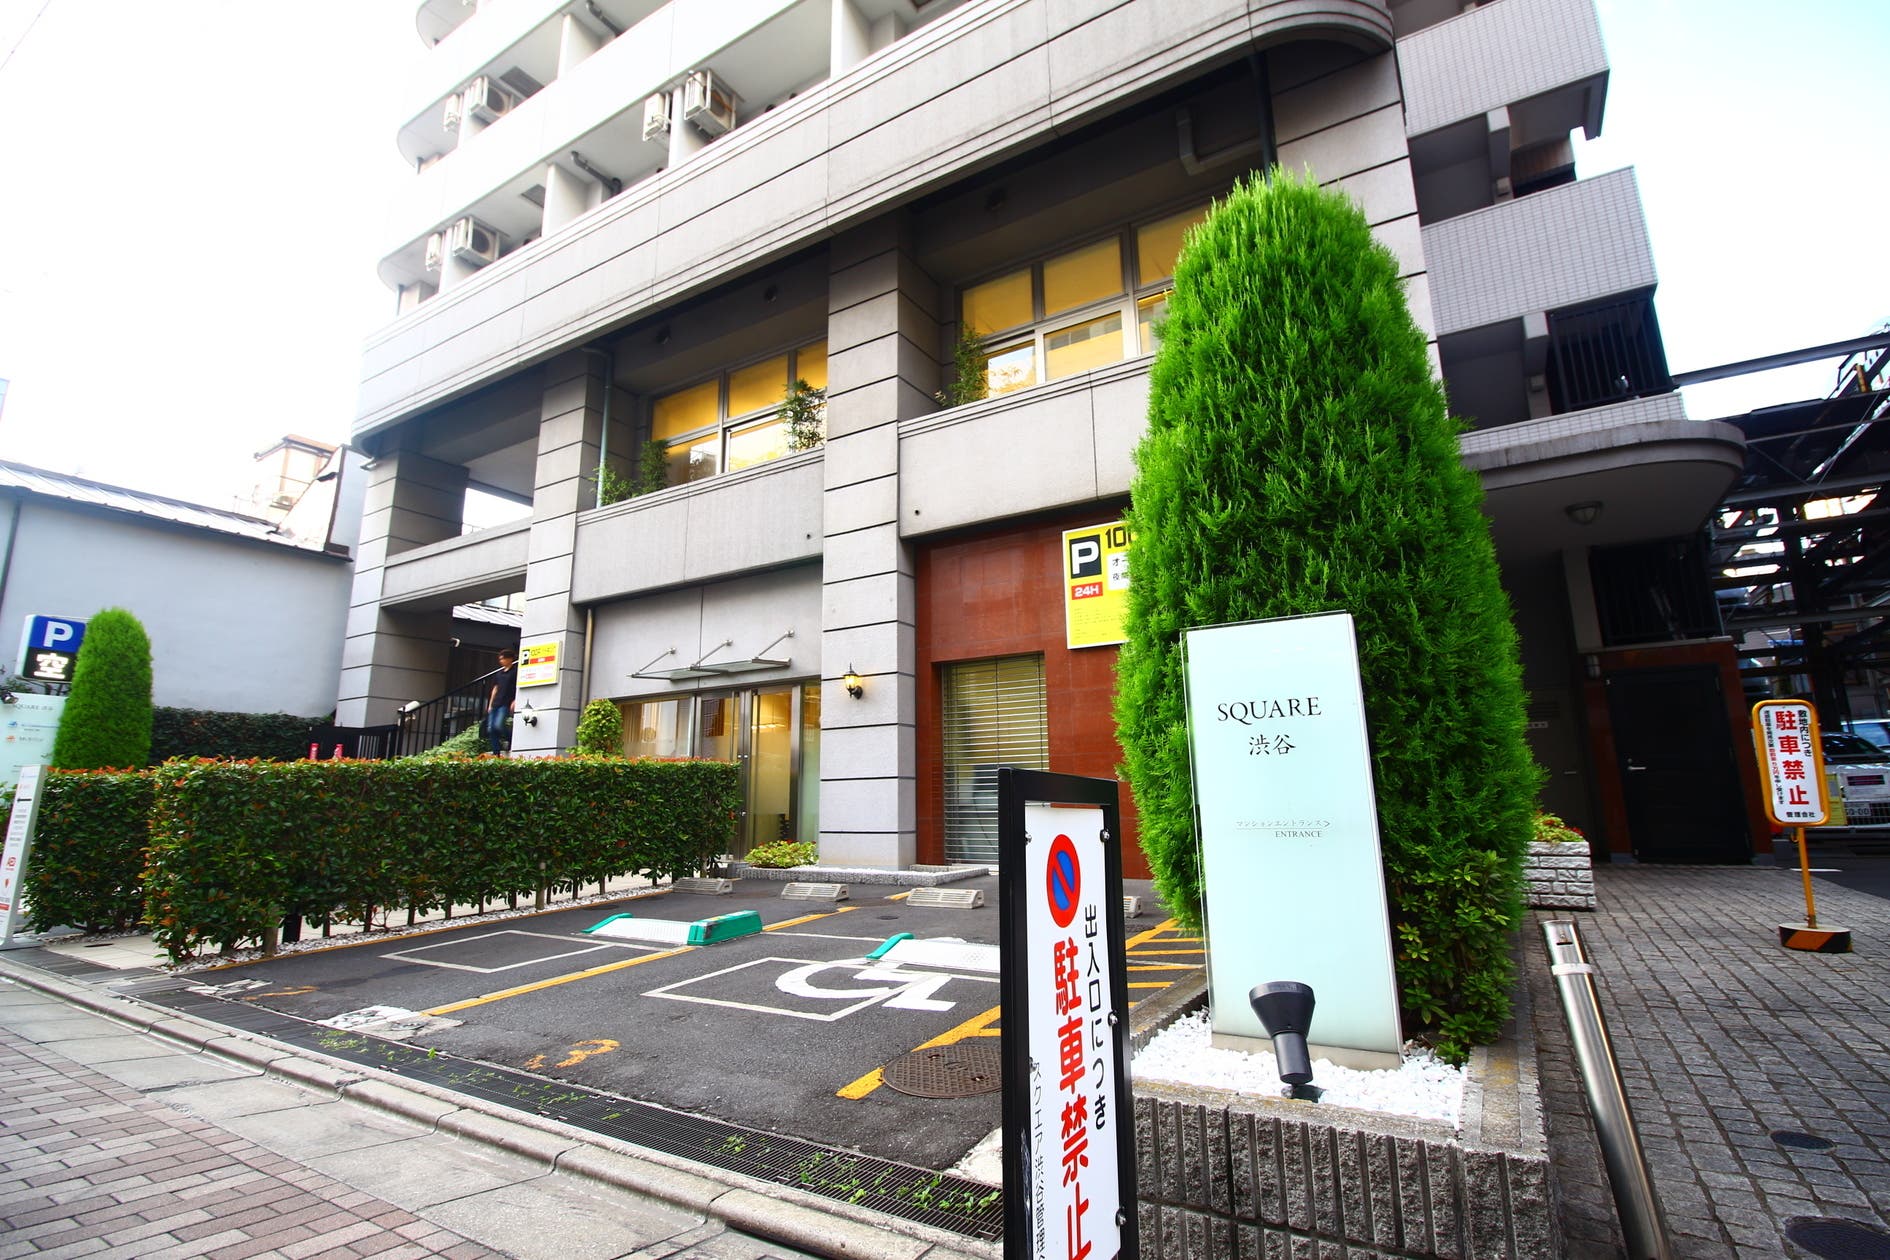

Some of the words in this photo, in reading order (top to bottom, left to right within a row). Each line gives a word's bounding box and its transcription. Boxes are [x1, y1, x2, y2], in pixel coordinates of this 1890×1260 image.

[1071, 540, 1100, 575] P
[1074, 584, 1100, 598] 24H
[43, 620, 74, 648] P
[34, 652, 69, 679] 空
[521, 650, 530, 666] P
[1217, 696, 1322, 726] SQUARE
[1248, 733, 1297, 756] 渋谷
[1775, 710, 1810, 805] 駐車禁止
[1236, 819, 1322, 828] マンションエントランス
[1275, 830, 1323, 838] ENTRANCE
[1084, 903, 1106, 1131] 出入口につき
[1053, 936, 1092, 1260] 駐車禁止
[1033, 1061, 1046, 1260] スクエア渋谷管理
